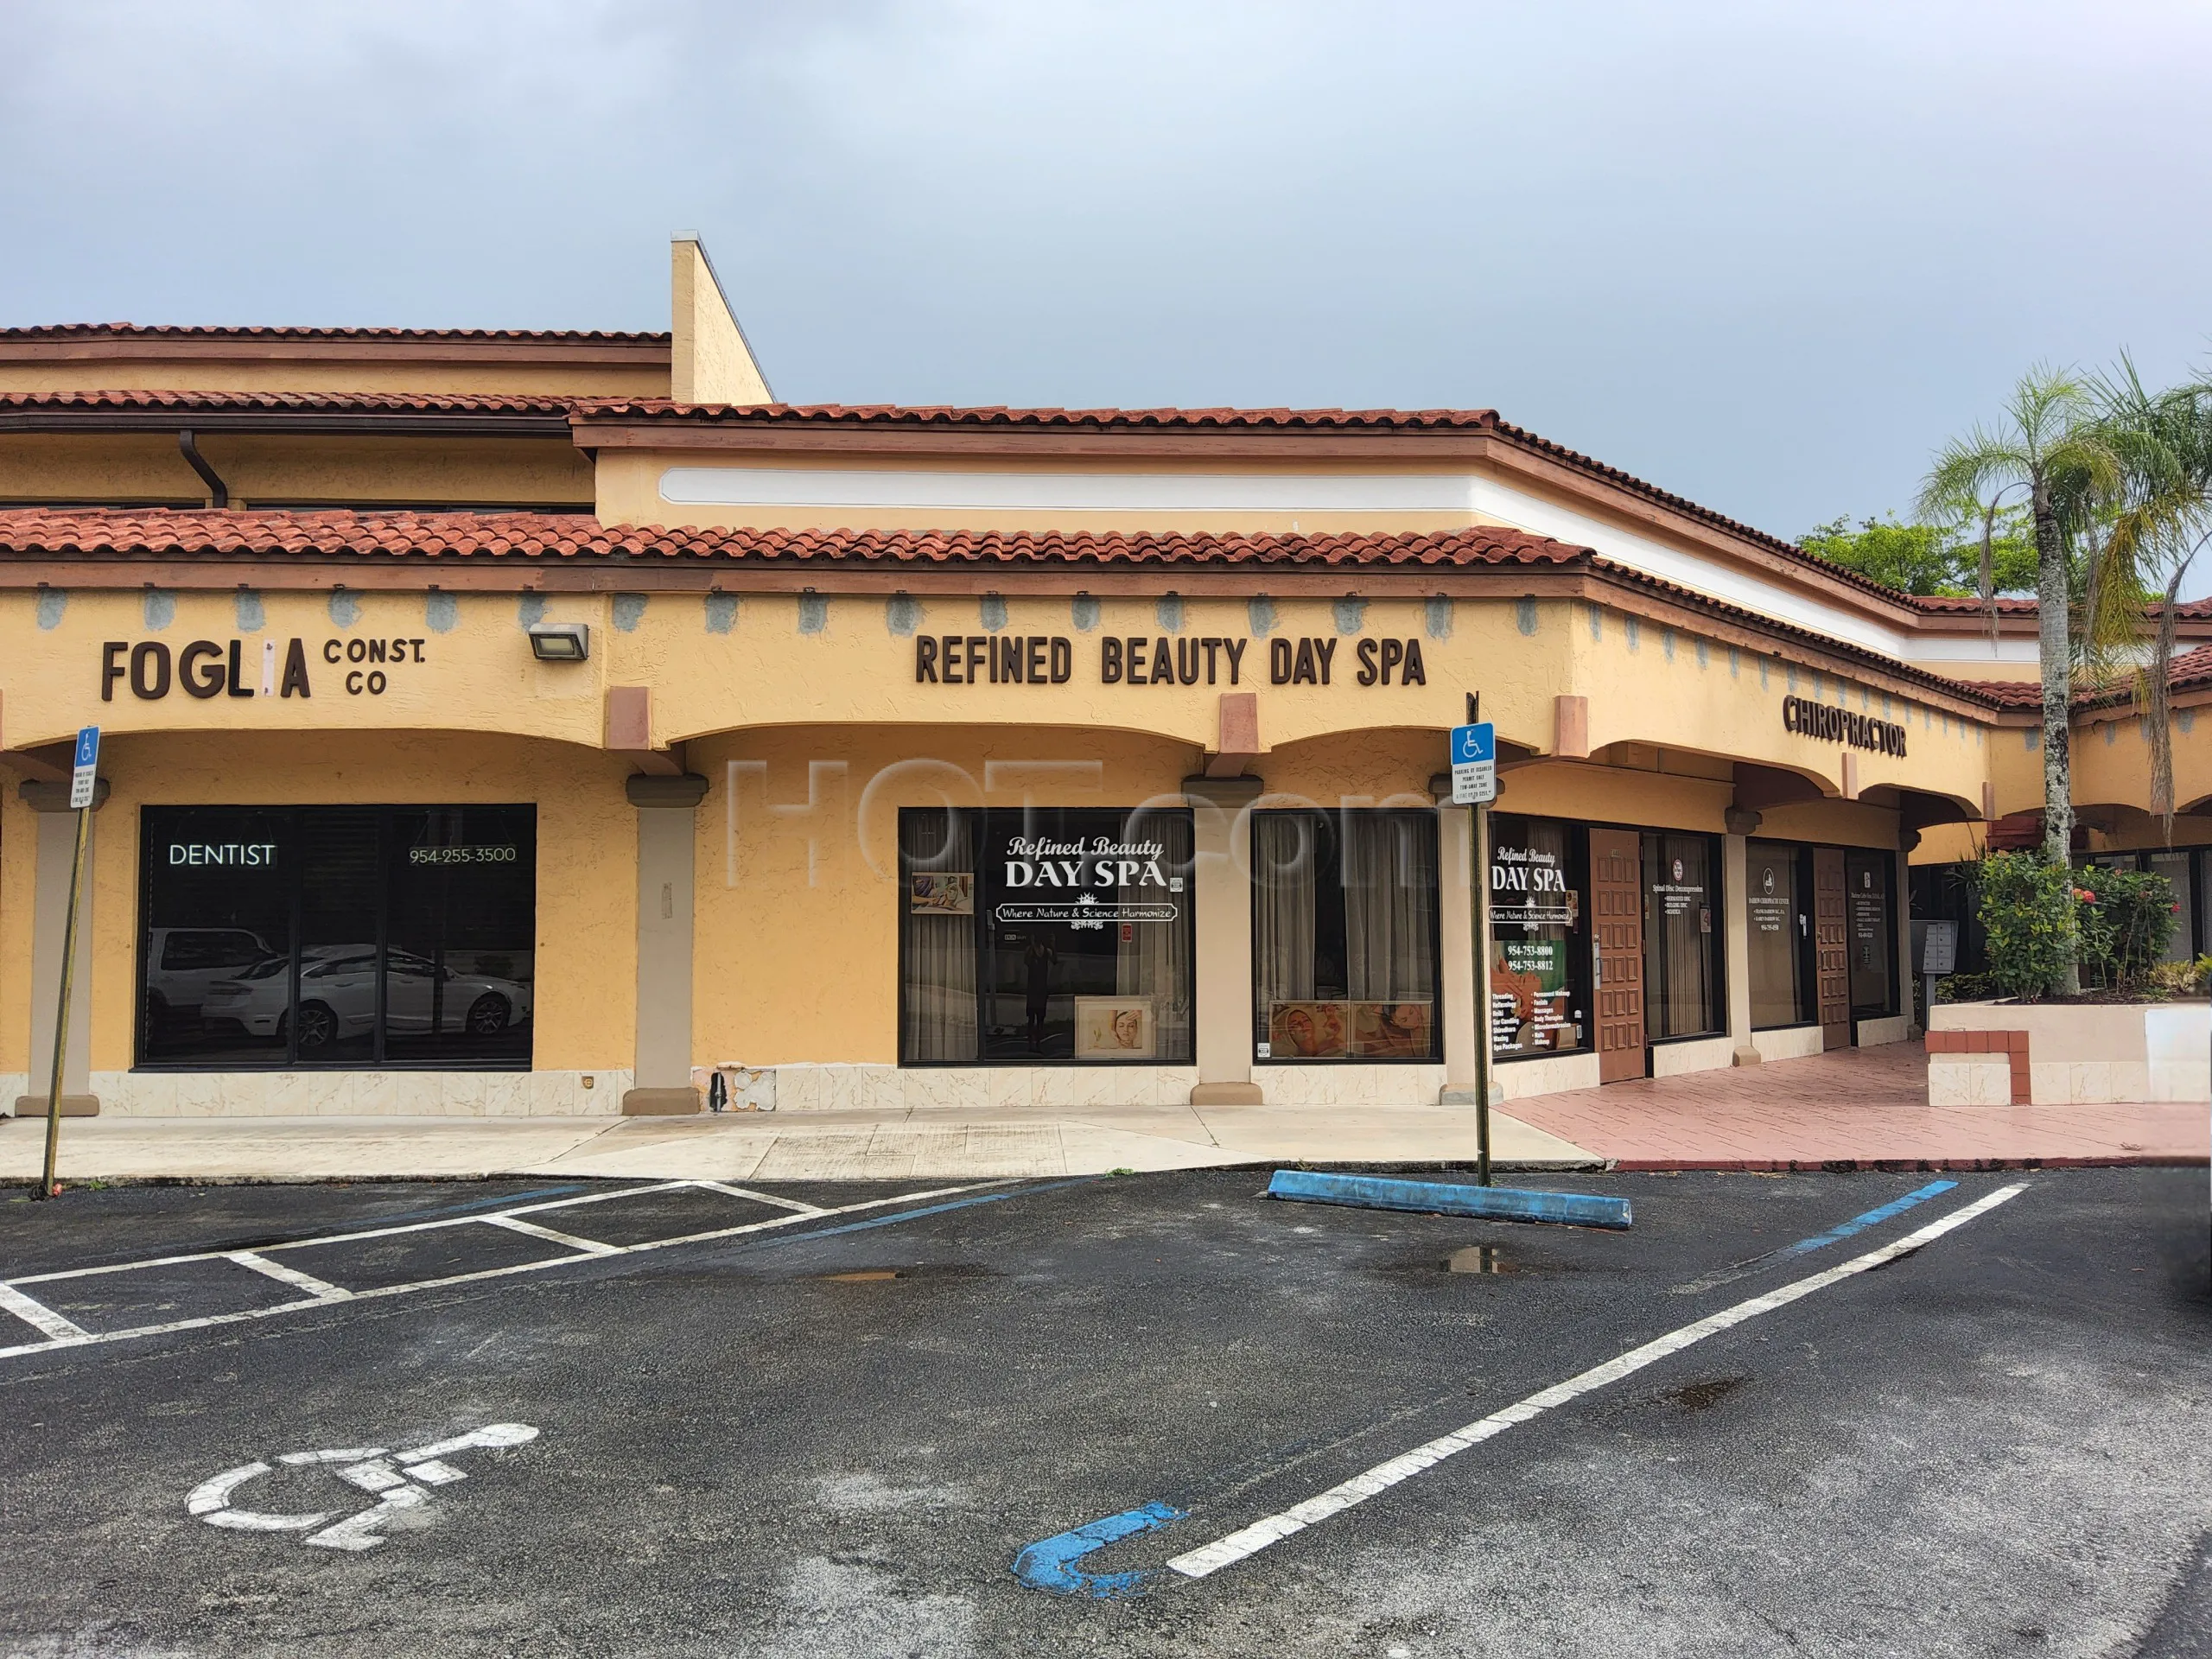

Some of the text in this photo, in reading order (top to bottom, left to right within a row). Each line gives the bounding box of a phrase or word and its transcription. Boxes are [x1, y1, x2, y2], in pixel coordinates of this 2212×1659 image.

[323, 638, 426, 664] CONST.
[916, 635, 1427, 686] REFINED BEAUTY DAY SPA
[346, 671, 387, 696] CO
[1783, 695, 1907, 757] CHIROPRACTOR
[168, 844, 276, 866] DENTIST
[409, 848, 516, 865] 954-255-3500
[1006, 836, 1164, 861] Refined Beauty
[1497, 846, 1555, 868] Refined Beauty
[1004, 861, 1084, 887] DAY
[1094, 861, 1167, 887] SPA
[1491, 865, 1566, 892] DAY SPA
[1652, 883, 1665, 893] Spinal
[1002, 907, 1172, 918] Where Nature & Science Harmonize
[1490, 910, 1505, 919] Where
[1506, 910, 1522, 919] Nature
[1522, 910, 1527, 919] &
[1528, 910, 1546, 919] Science
[1508, 945, 1553, 956] 954-753-8800
[1508, 960, 1553, 970] 954-753-8812
